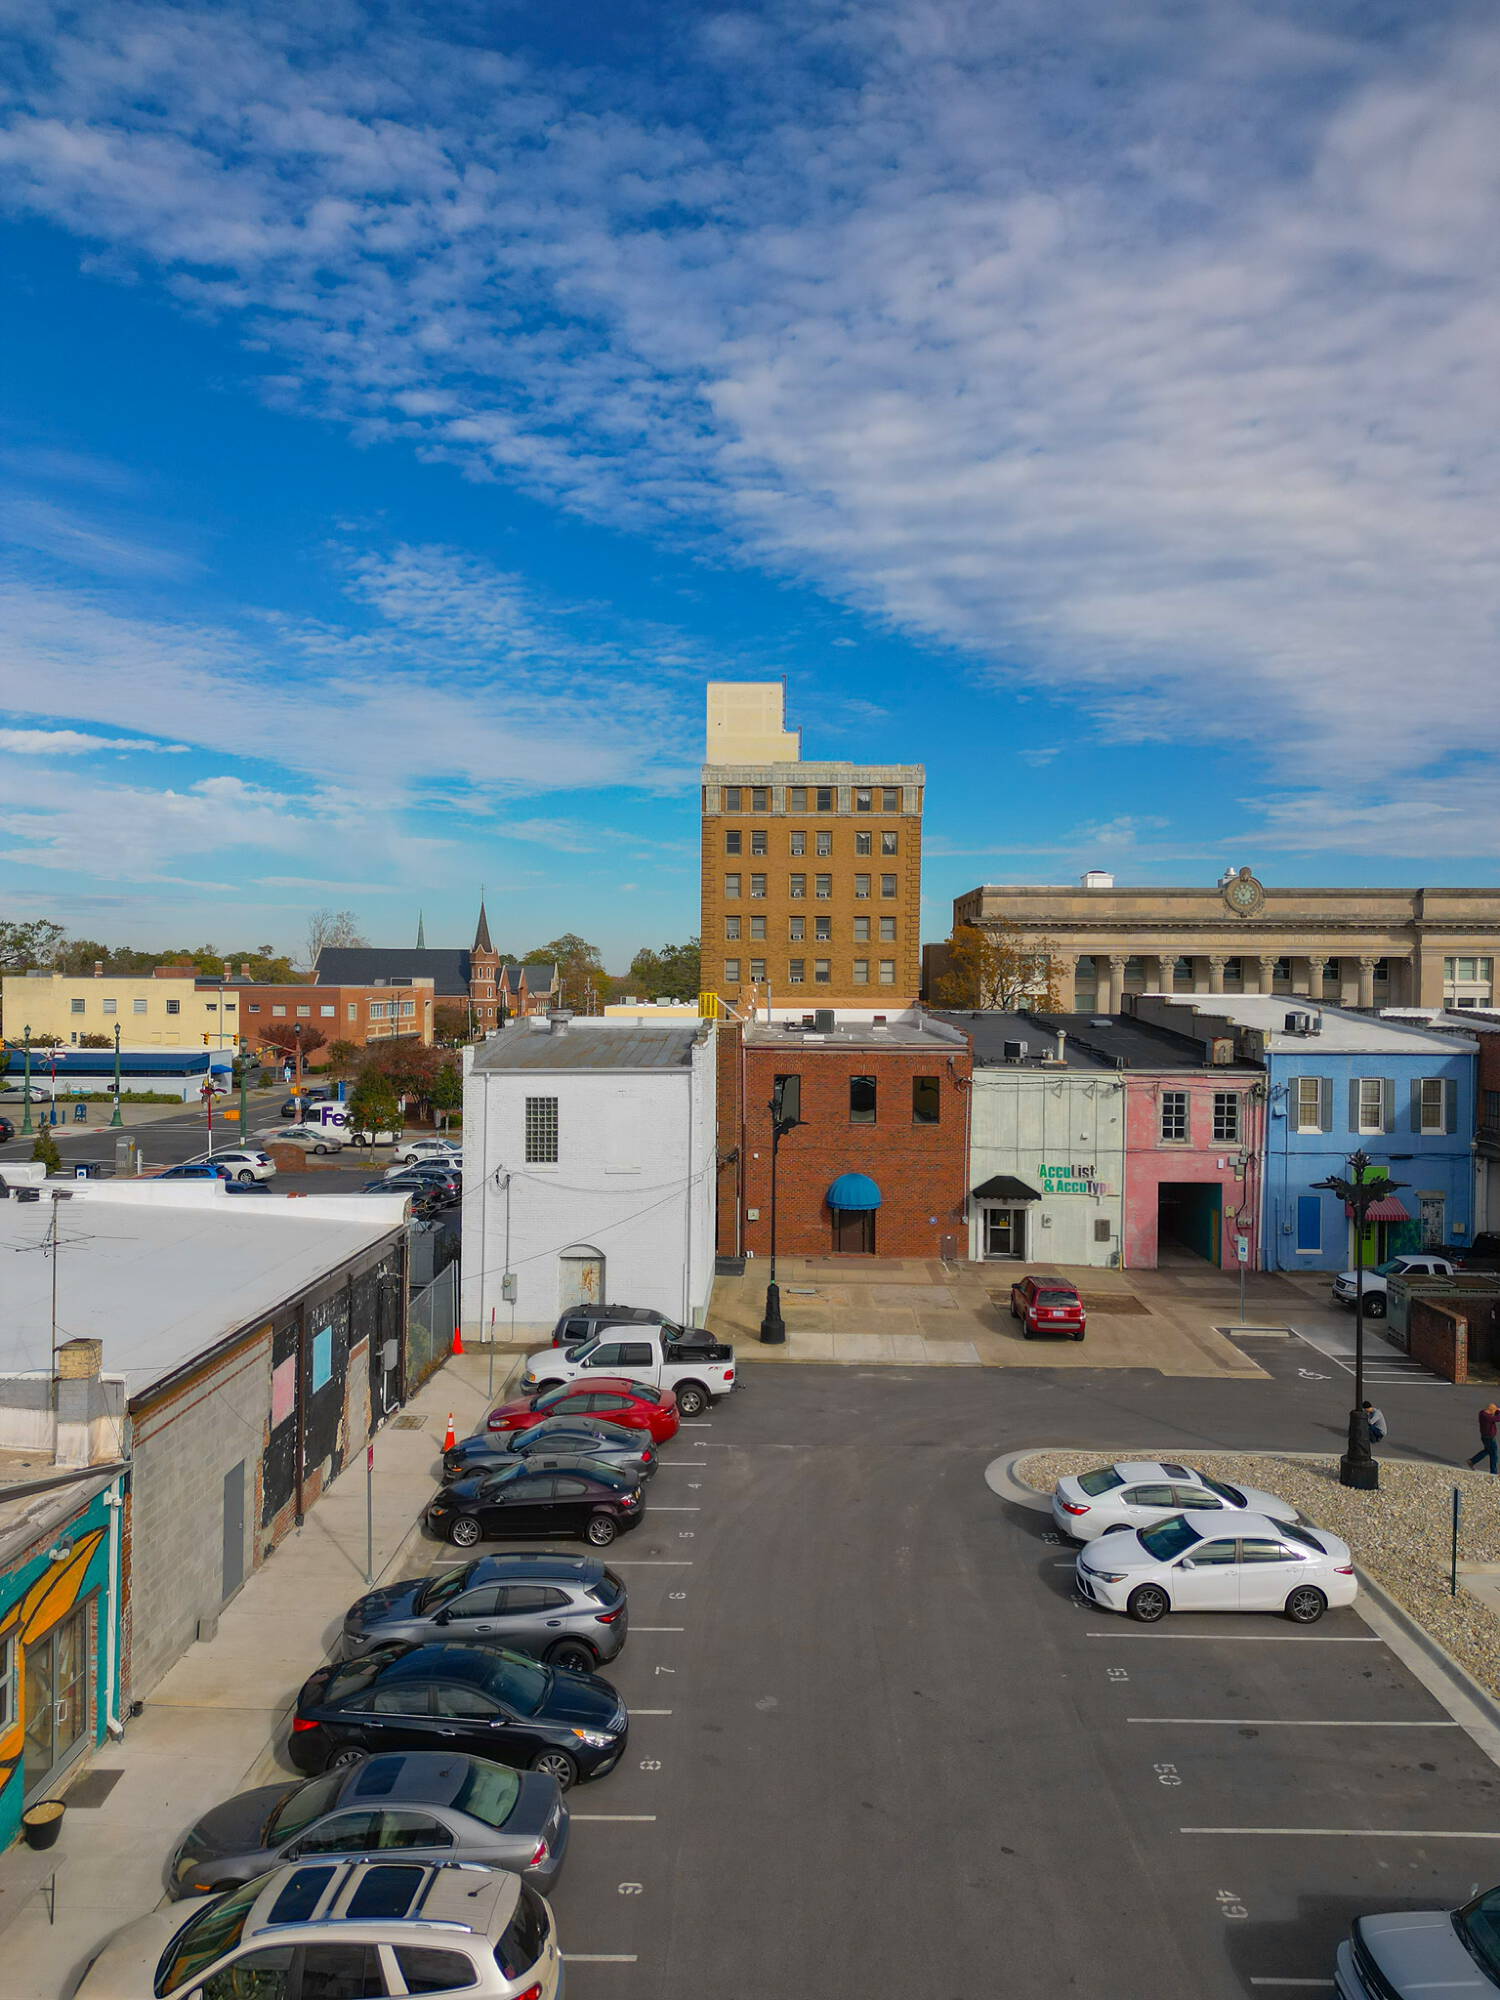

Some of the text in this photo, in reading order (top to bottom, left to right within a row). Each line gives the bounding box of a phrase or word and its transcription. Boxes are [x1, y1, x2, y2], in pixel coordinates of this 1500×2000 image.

[321, 1106, 354, 1127] Fe
[1039, 1164, 1096, 1178] AccuList
[1043, 1179, 1054, 1192] &
[688, 1482, 702, 1490] 4
[678, 1531, 695, 1539] 5
[668, 1591, 687, 1600] 6
[655, 1666, 676, 1677] 7
[639, 1759, 662, 1772] 8
[1153, 1763, 1182, 1785] 50
[617, 1881, 644, 1896] 9
[1215, 1890, 1249, 1919] 49
